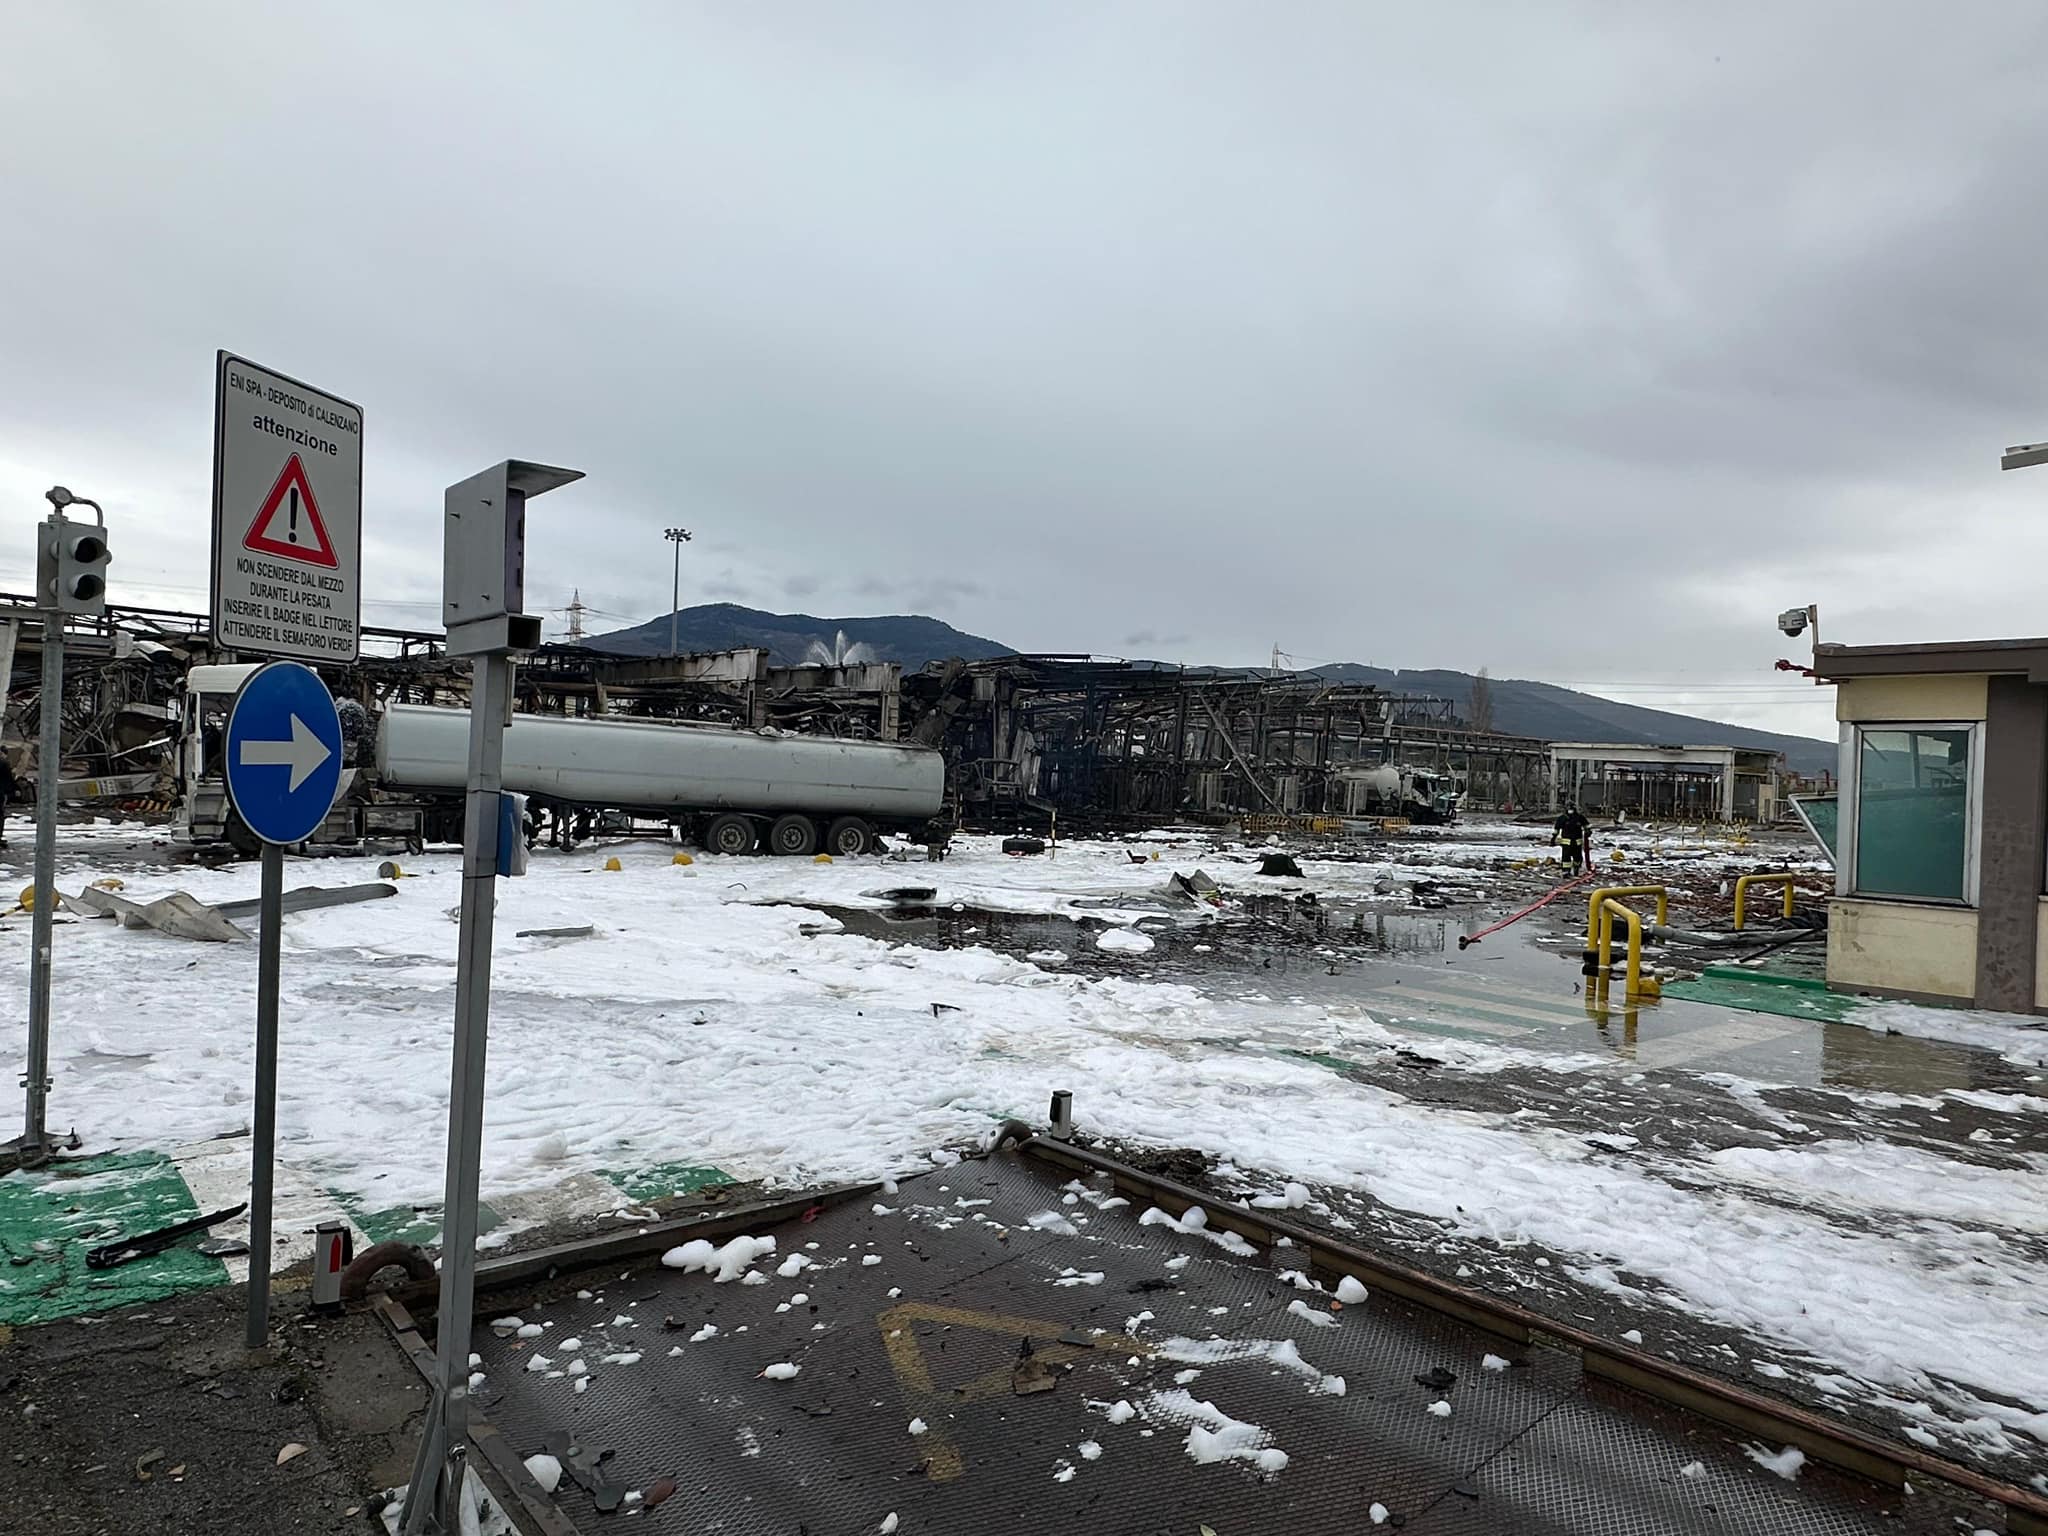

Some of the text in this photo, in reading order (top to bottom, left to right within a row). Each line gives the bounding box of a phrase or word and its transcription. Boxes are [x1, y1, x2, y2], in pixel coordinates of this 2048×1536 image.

[231, 373, 244, 391] ENI
[246, 379, 262, 399] SPA
[268, 388, 306, 415] DEPOSITO
[308, 406, 314, 418] di
[316, 407, 358, 434] CALENZANO
[253, 415, 337, 456] attenzione
[237, 557, 344, 593] NON SCENDERE DAL MEZZO
[250, 582, 331, 610] DURANTE LA PESATA
[224, 598, 352, 633] INSERIRE IL BADGE NEL LETTORE
[223, 621, 272, 641] ATTENDERE
[274, 629, 280, 642] IL
[282, 631, 326, 648] SEMAFORO
